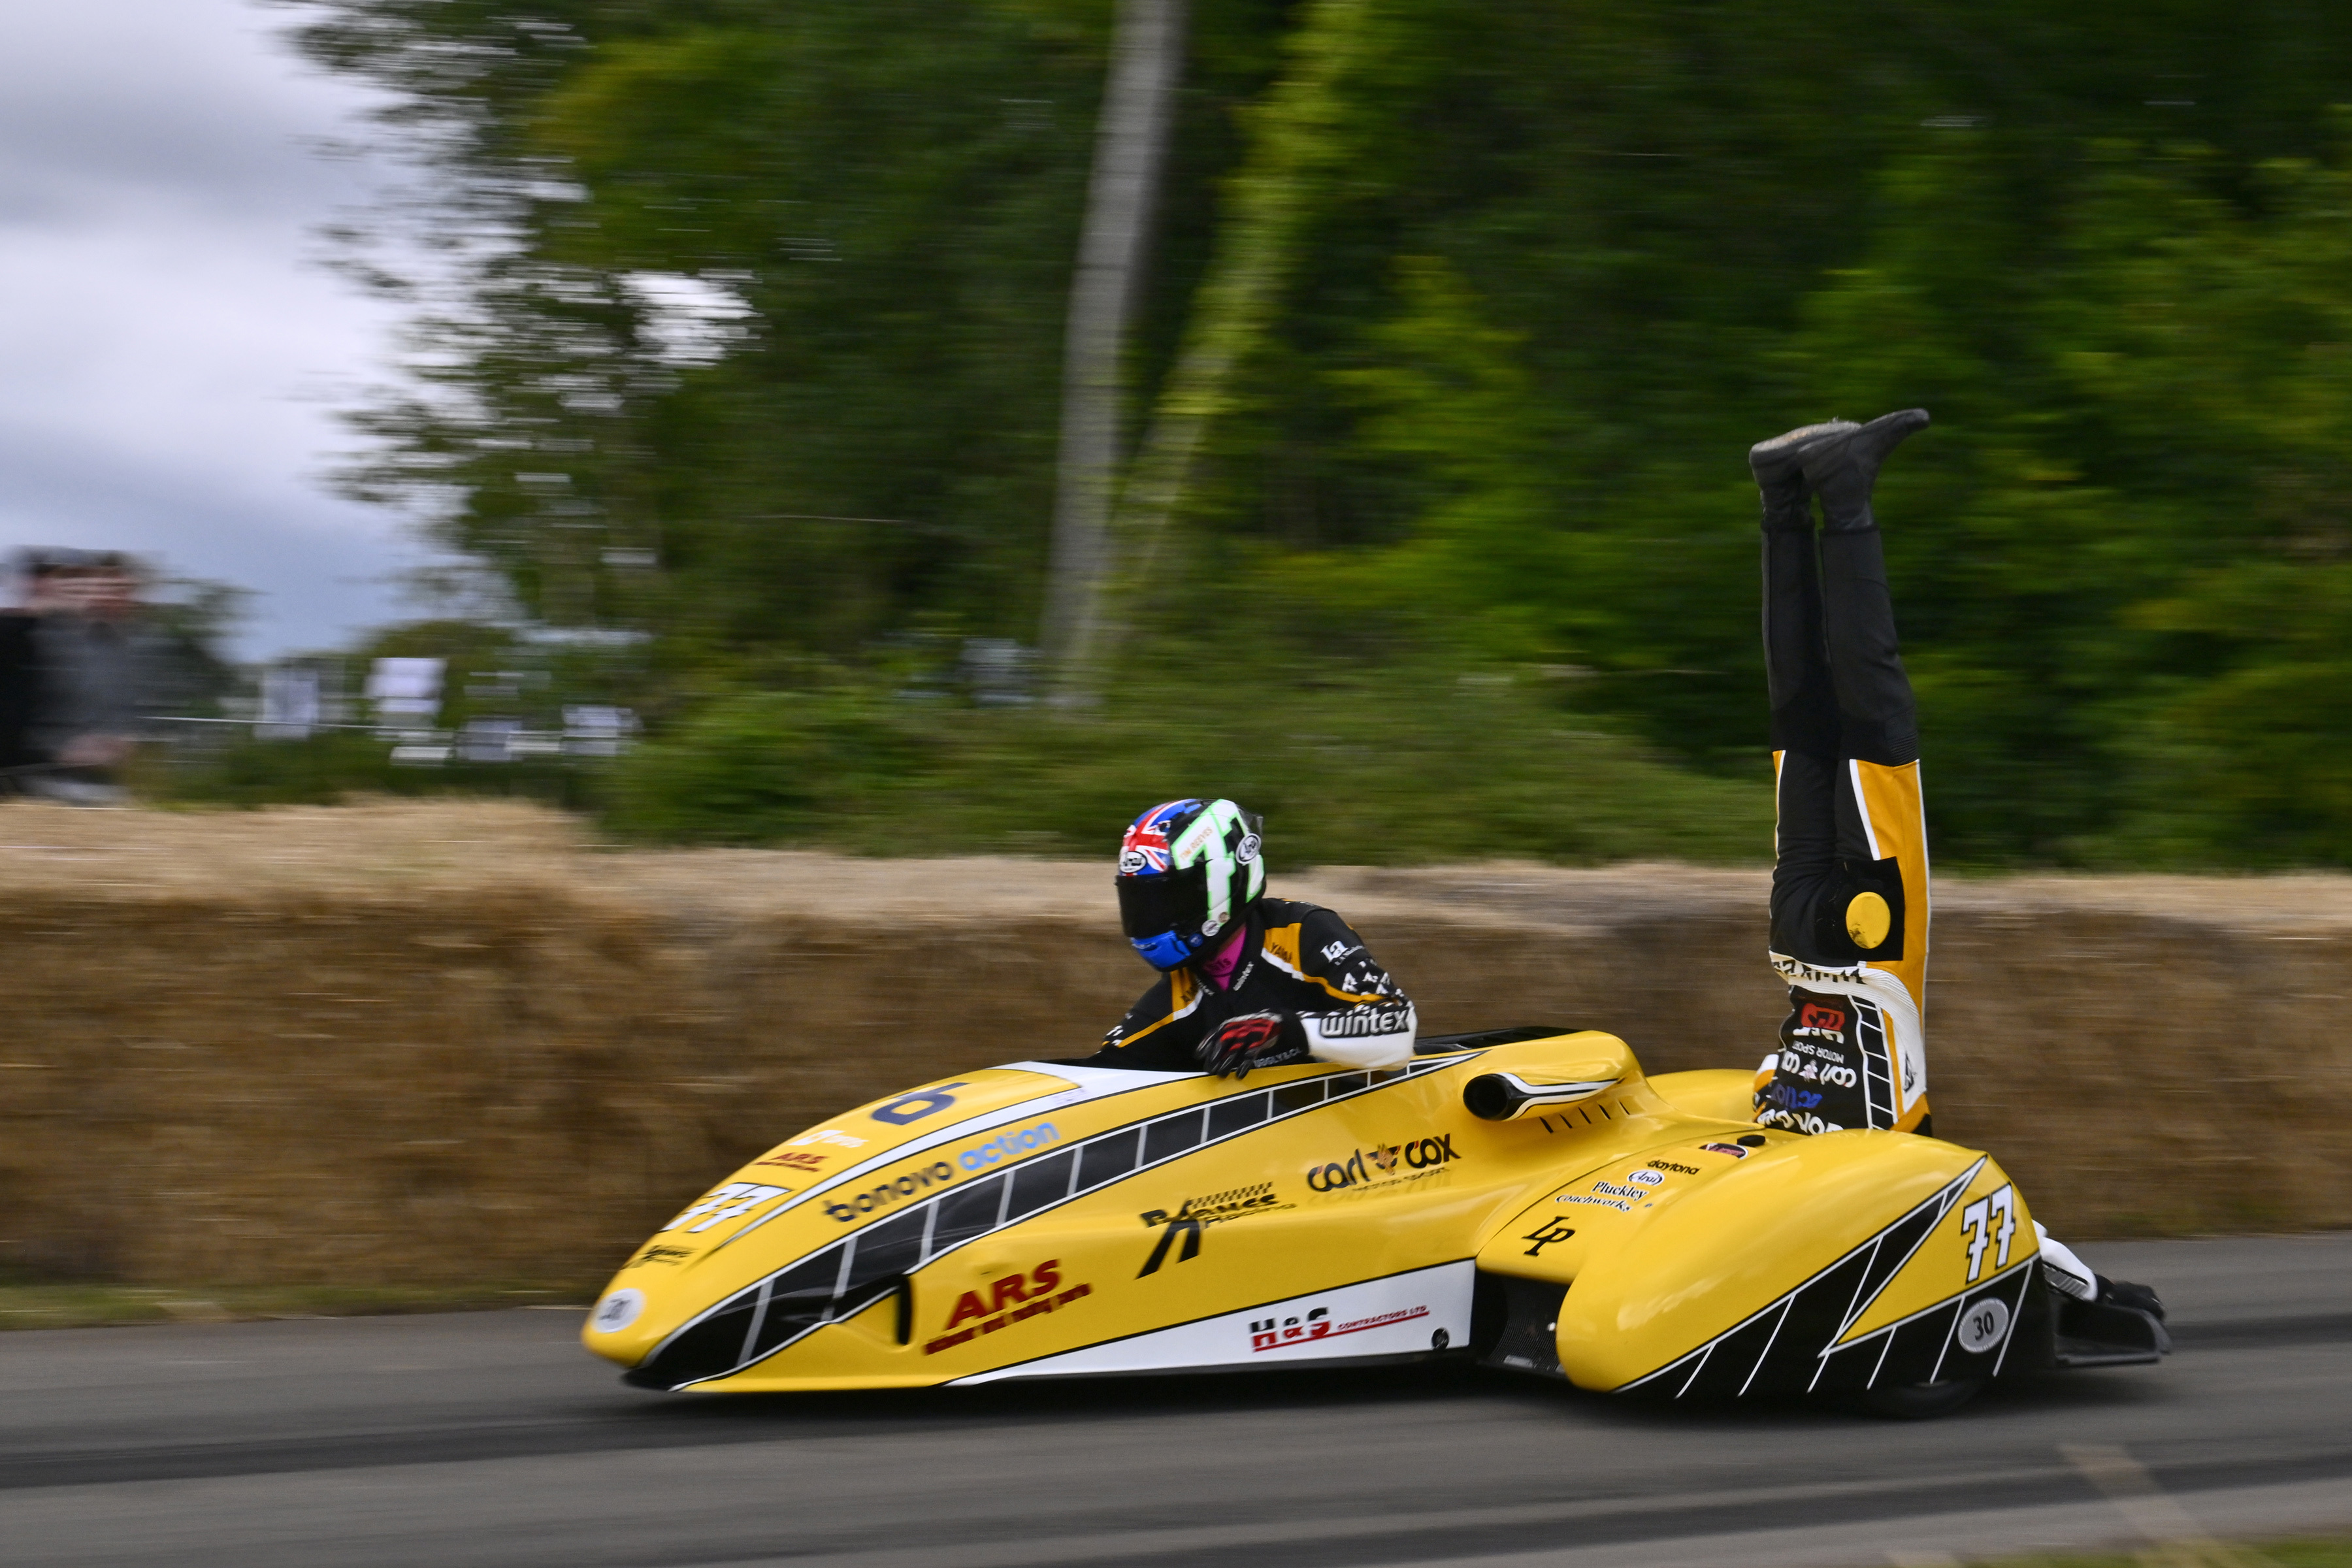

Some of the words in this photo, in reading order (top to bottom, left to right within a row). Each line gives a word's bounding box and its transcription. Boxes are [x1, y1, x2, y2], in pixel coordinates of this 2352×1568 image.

[1321, 1008, 1408, 1036] wintex
[1816, 1051, 1844, 1064] MOTOR
[769, 1152, 829, 1164] ARS
[1405, 1133, 1462, 1169] cox
[823, 1162, 953, 1222] bonovo
[958, 1122, 1061, 1171] action
[1646, 1159, 1701, 1175] daytona
[1591, 1181, 1648, 1201] Pluckley
[659, 1182, 793, 1233] 77
[1961, 1181, 2016, 1284] 77
[945, 1258, 1061, 1330] ARS
[1338, 1309, 1408, 1331] CONTRACTORS
[1409, 1305, 1428, 1315] LTD
[1973, 1311, 1994, 1341] 30
